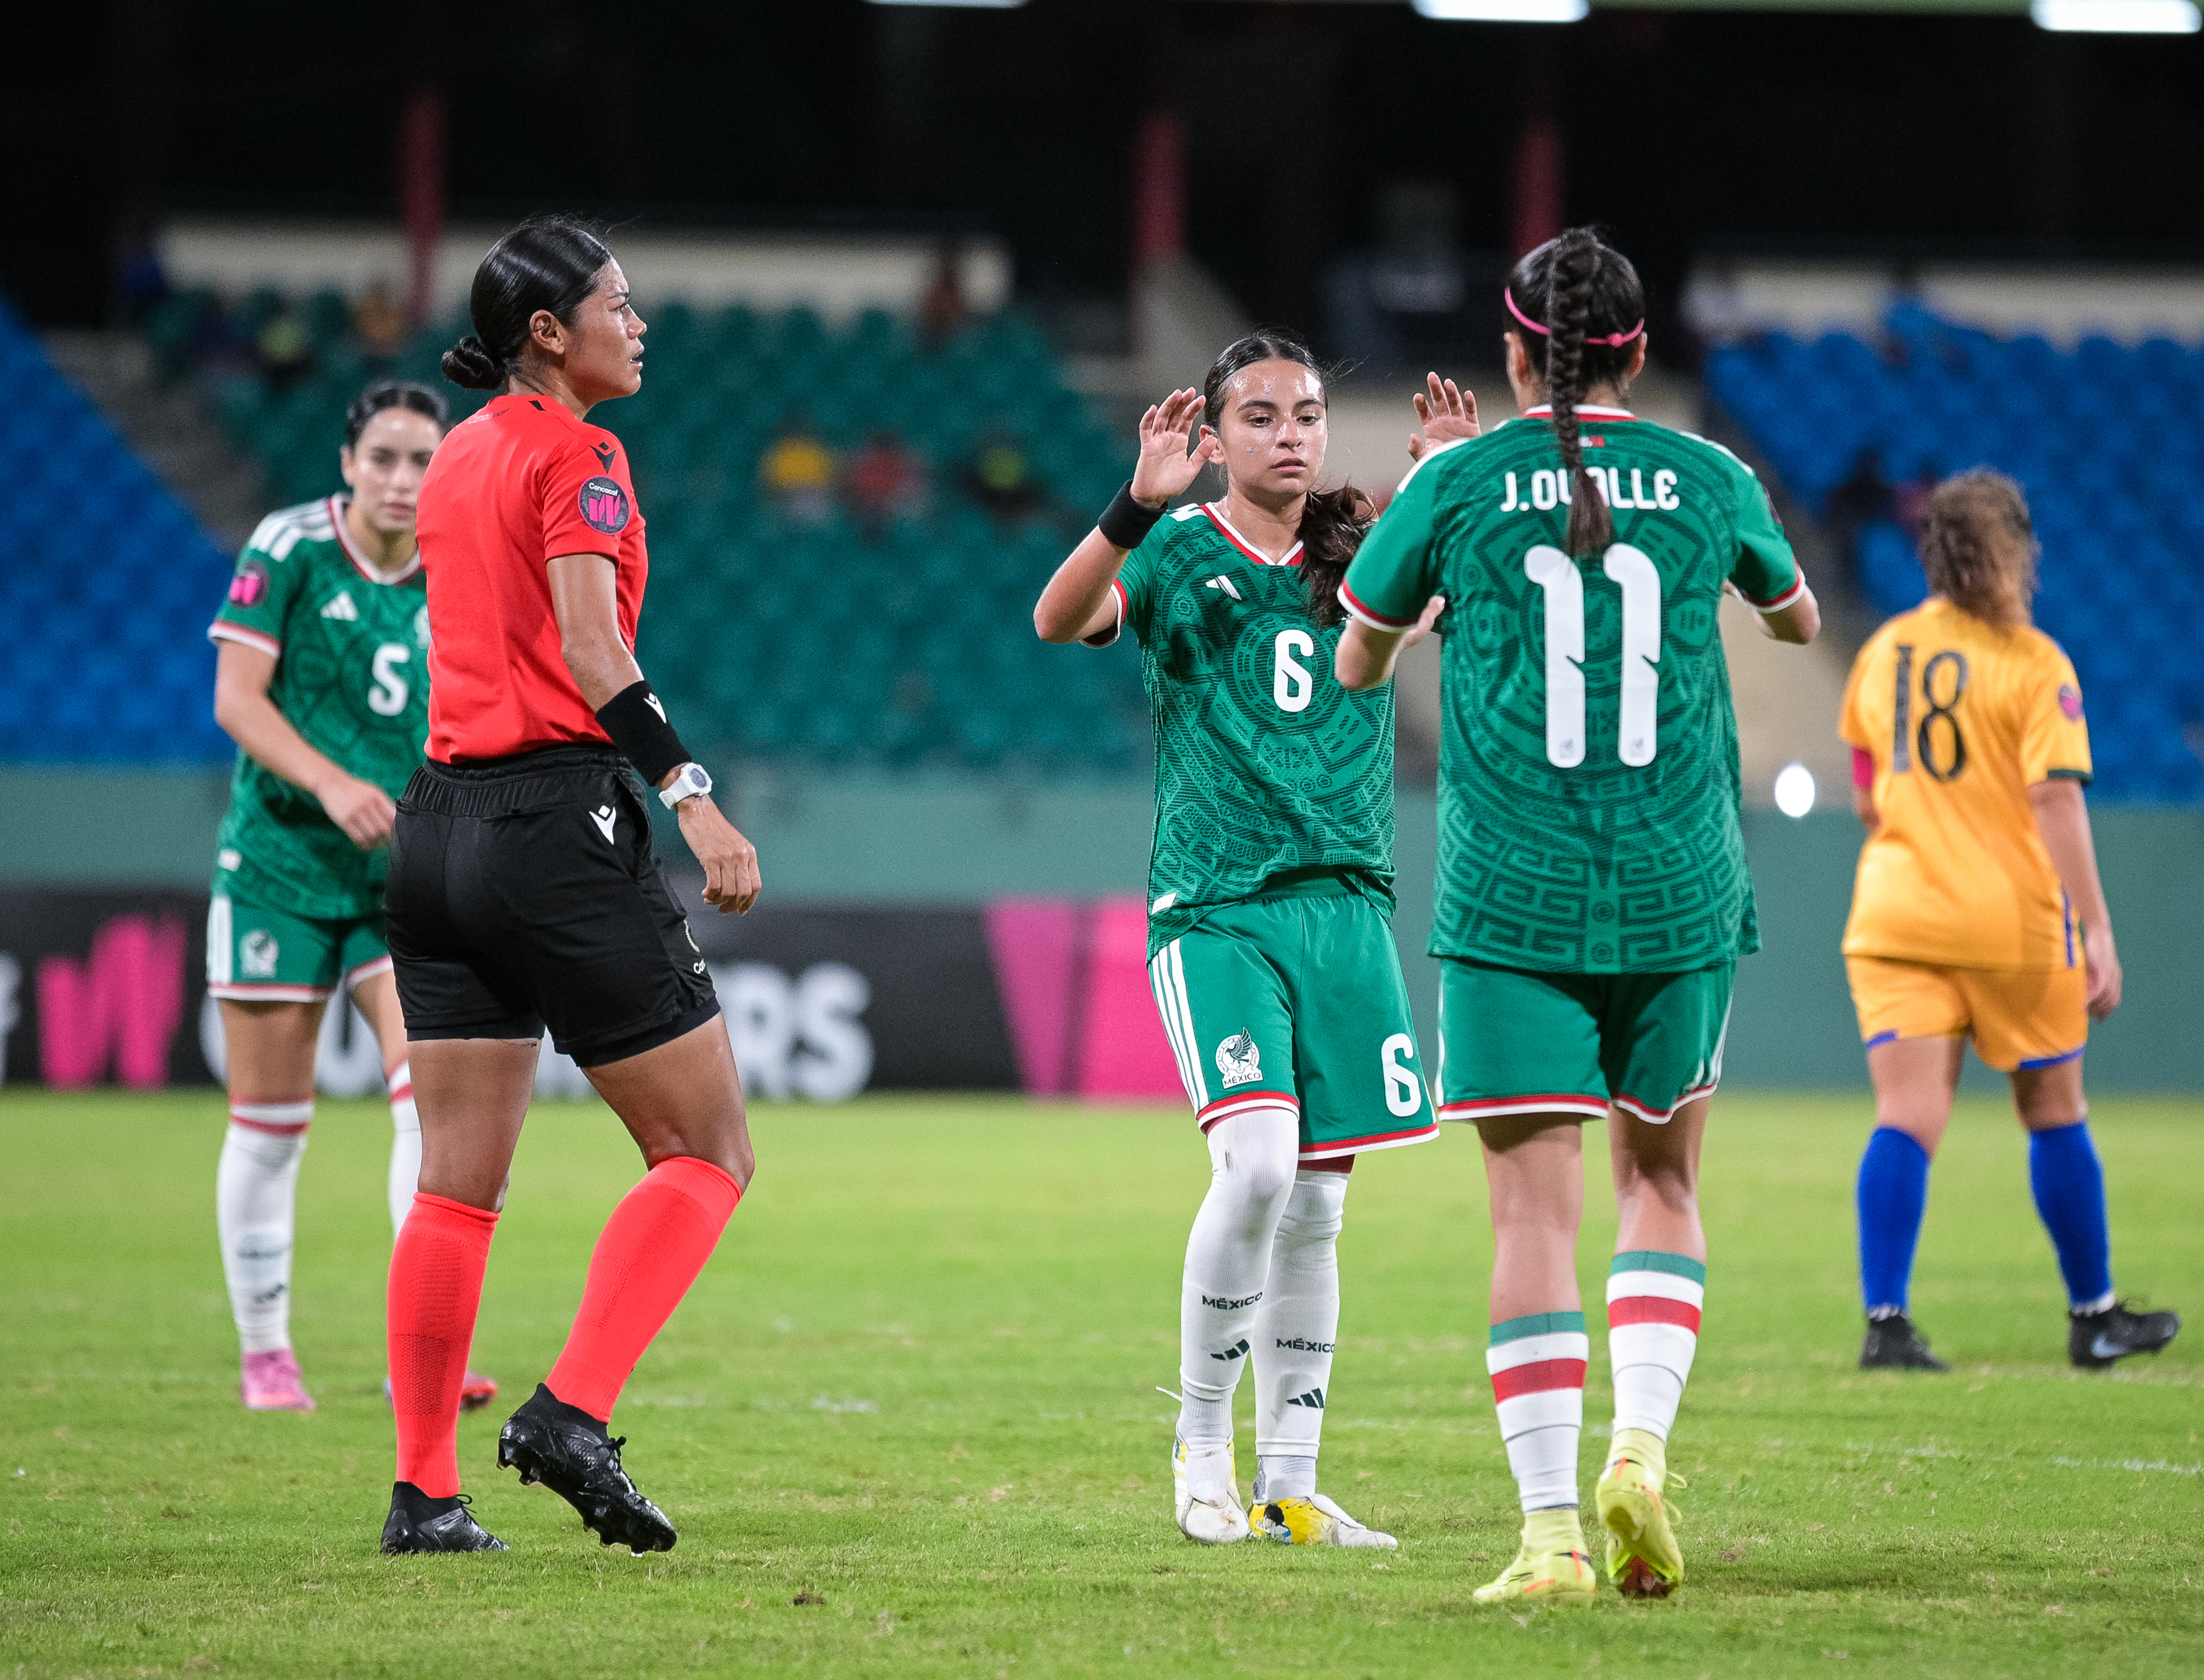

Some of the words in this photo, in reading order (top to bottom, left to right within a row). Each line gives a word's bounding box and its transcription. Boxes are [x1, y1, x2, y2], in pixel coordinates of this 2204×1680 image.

[588, 482, 619, 496] Concacaf
[368, 643, 410, 717] 5
[1274, 629, 1314, 712] 6
[1524, 542, 1662, 768] 11
[1892, 645, 1969, 782] 18
[1224, 1073, 1261, 1087] MÉXICO
[1381, 1033, 1422, 1117] 6
[1202, 1292, 1263, 1310] MÉXICO
